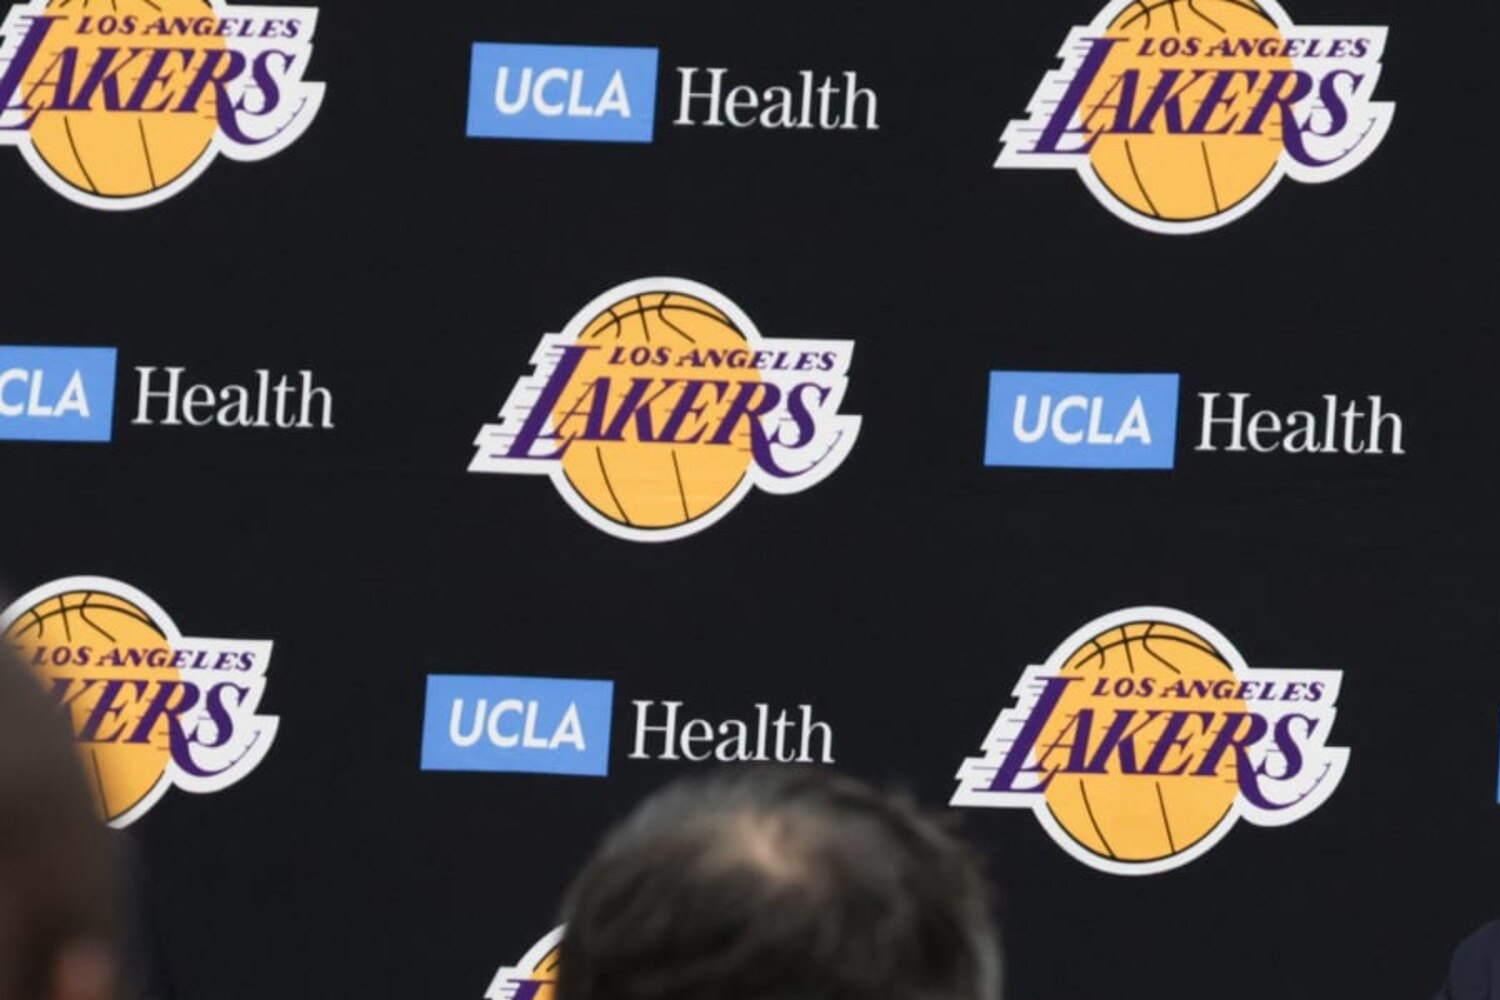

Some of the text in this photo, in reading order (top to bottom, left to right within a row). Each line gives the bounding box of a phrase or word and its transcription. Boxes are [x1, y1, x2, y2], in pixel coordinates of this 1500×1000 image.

[76, 15, 300, 38] LOS ANGELES
[1136, 37, 1369, 59] LOS ANGELES
[0, 15, 308, 145] LAKERS
[495, 66, 879, 129] UCLA Health
[1016, 37, 1378, 168] LAKERS
[608, 346, 836, 371] LOS ANGELES
[0, 366, 335, 428] CLA Health
[489, 344, 843, 478] LAKERS
[1012, 392, 1405, 454] UCLA Health
[30, 646, 256, 672] LOS ANGELES
[1090, 677, 1325, 702] LOS ANGELES
[50, 677, 261, 777] KERS
[448, 699, 836, 763] UCLA Health
[971, 675, 1332, 812] LAKERS
